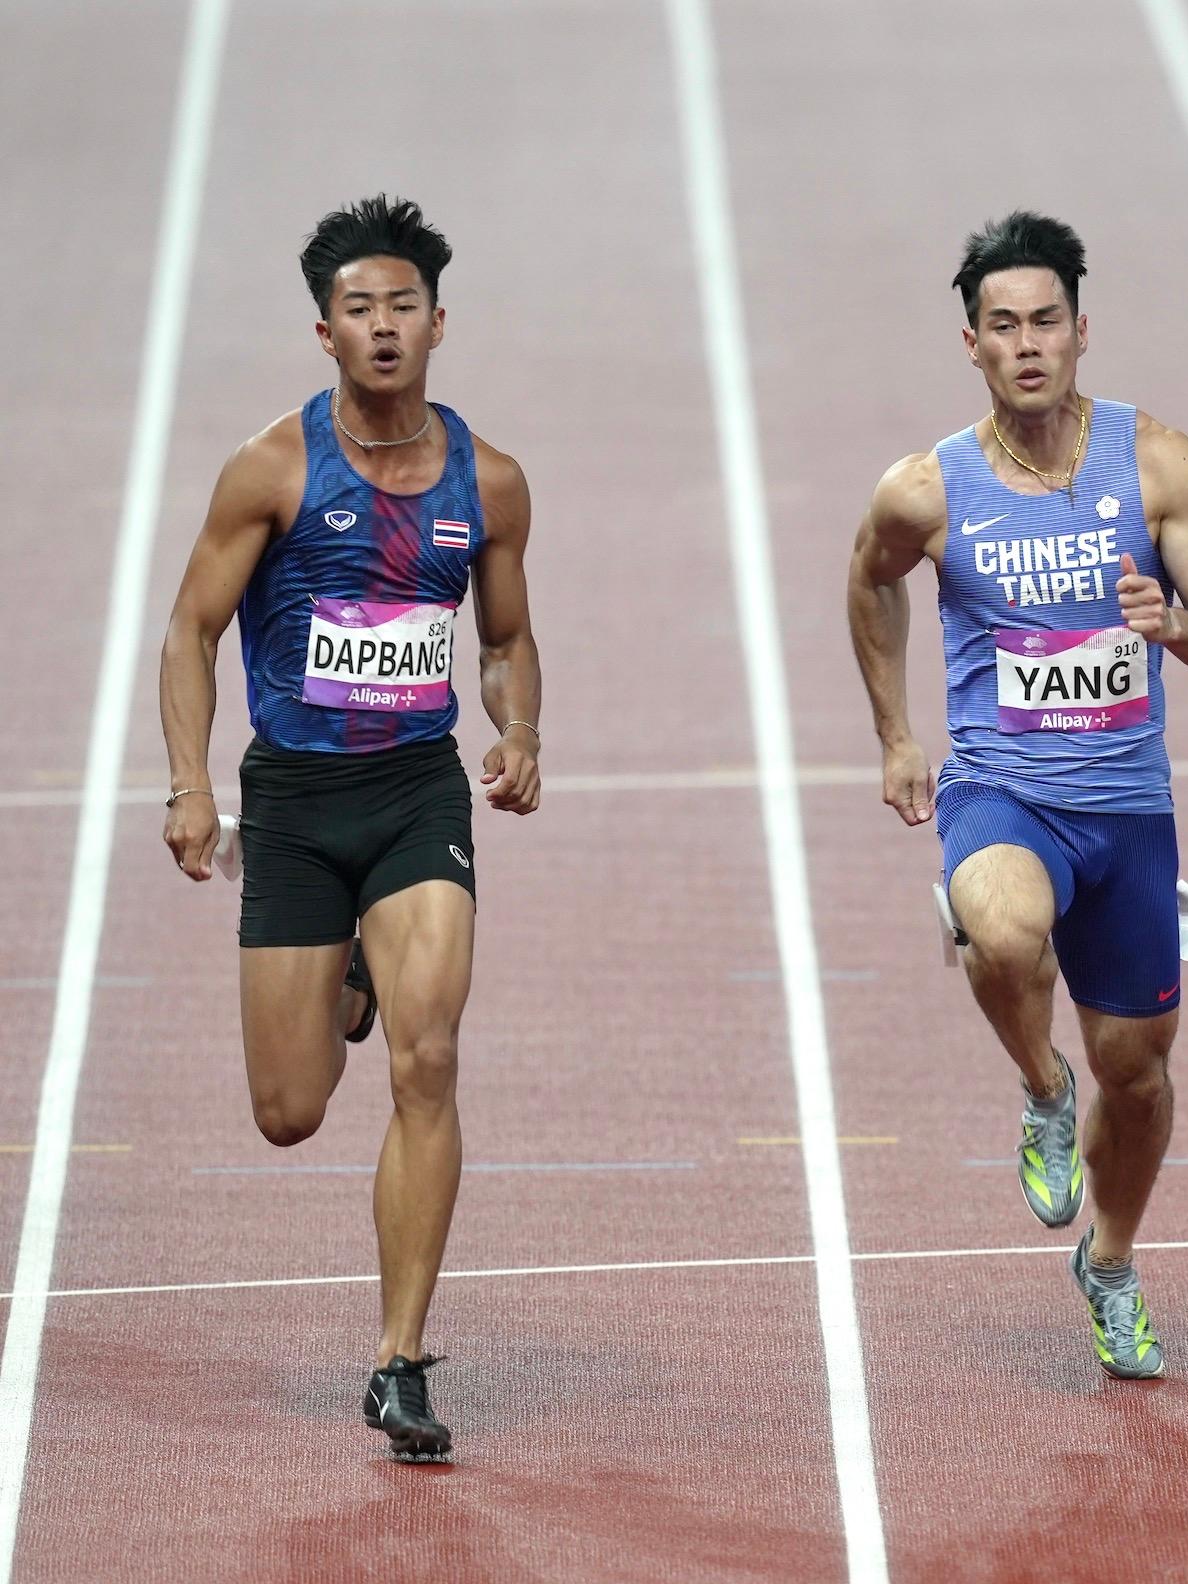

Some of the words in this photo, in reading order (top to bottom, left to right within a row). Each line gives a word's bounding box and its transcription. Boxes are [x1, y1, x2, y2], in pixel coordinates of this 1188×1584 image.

[975, 528, 1121, 575] CHINESE
[996, 568, 1105, 607] TAIPEI
[428, 621, 446, 637] 826
[313, 634, 446, 677] DAPBANG
[1114, 641, 1139, 659] 910
[1015, 660, 1131, 701] YANG
